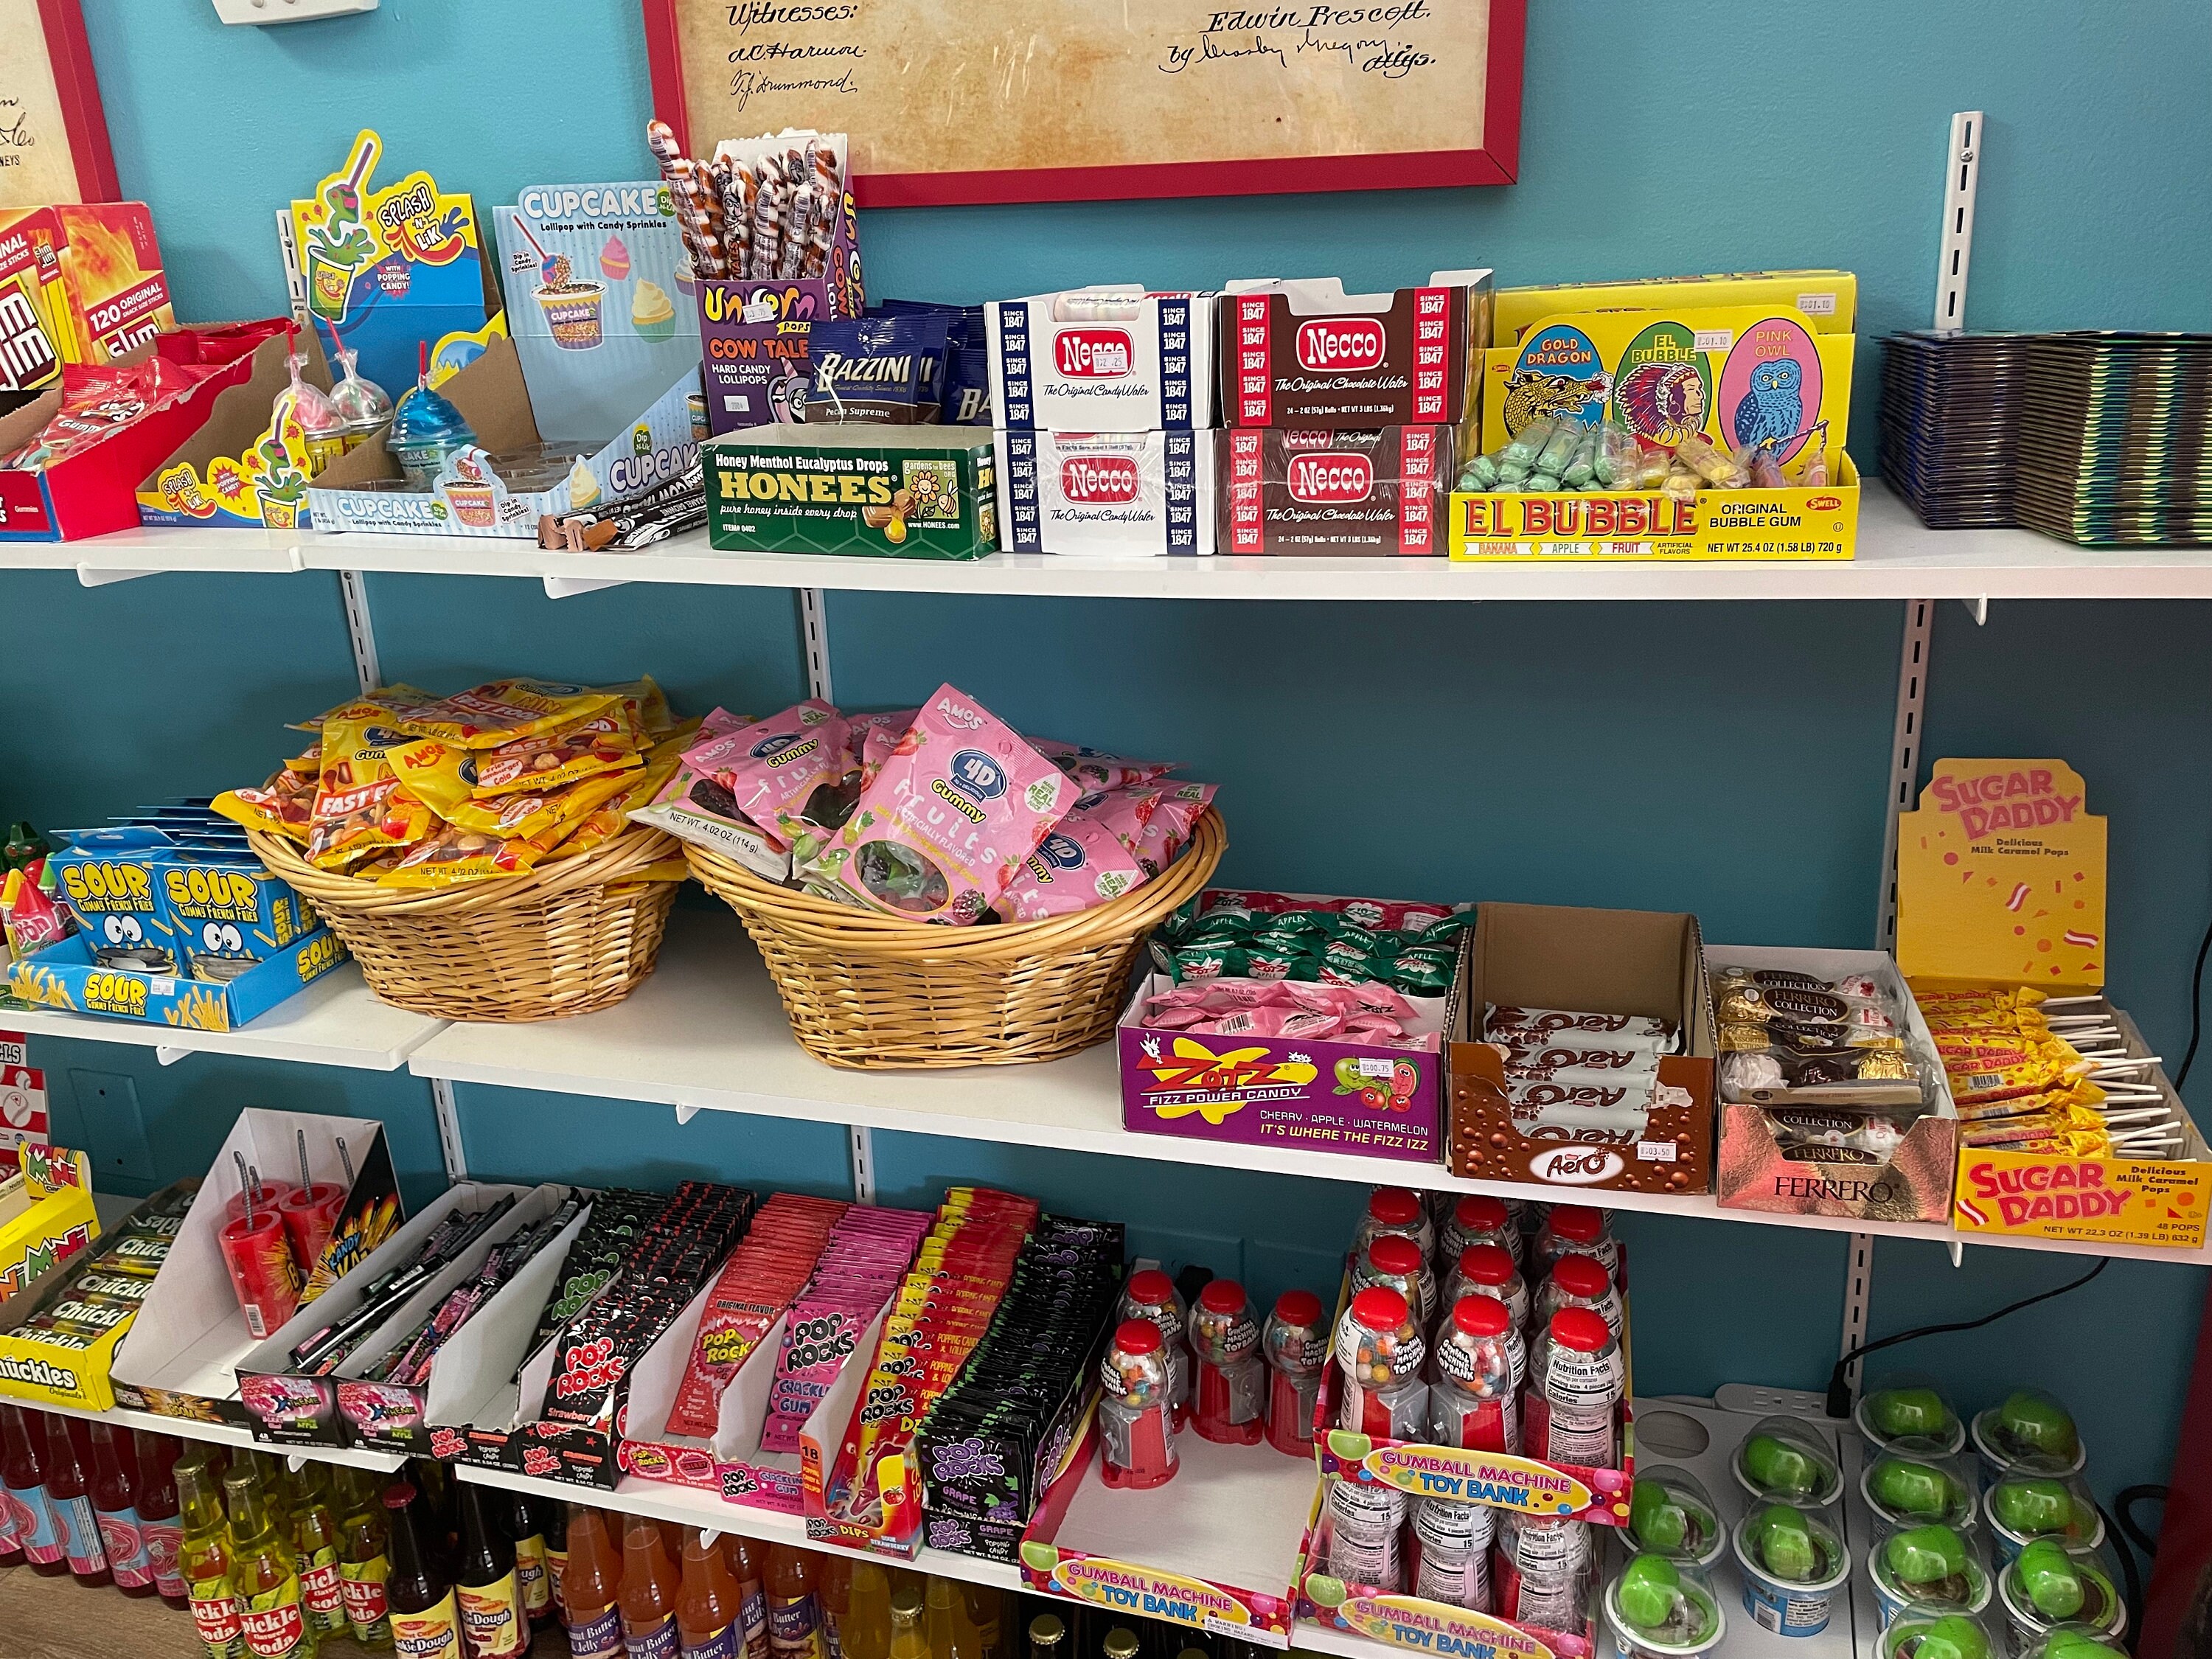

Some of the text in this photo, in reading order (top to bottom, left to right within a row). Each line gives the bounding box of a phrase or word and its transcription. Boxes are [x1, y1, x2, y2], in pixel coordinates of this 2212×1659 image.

[726, 1, 858, 35] Witnesses:
[1198, 0, 1431, 33] Edwin Prescott.
[381, 187, 430, 226] SPLASH
[524, 188, 657, 219] CUPCAKE
[540, 220, 667, 232] Lollipop with Candy Sprinkles
[377, 273, 410, 282] POPPING
[380, 282, 409, 291] CANDY!
[120, 282, 162, 309] ORIGINAL
[122, 293, 163, 317] SNACK SIZE STICKS
[90, 304, 121, 332] 120
[1004, 316, 1023, 327] 1847
[1541, 338, 1579, 352] GOLD
[1655, 335, 1675, 348] EL
[1756, 330, 1792, 342] PINK
[709, 338, 757, 359] COW
[1307, 328, 1377, 365] Necco
[1631, 348, 1696, 362] BUBBLE
[1755, 344, 1790, 357] OWL
[1526, 349, 1592, 366] DRAGON
[712, 364, 771, 375] HARD CANDY
[817, 354, 911, 392] BAZZINI
[718, 375, 767, 384] LOLLIPOPS
[1274, 376, 1408, 392] The Original Chocolate Wafer
[850, 407, 890, 417] Supreme
[715, 453, 888, 472] Honey Menthol Eucalyptus Drops
[903, 461, 956, 475] gardens bees
[718, 472, 892, 505] HONEES
[1069, 464, 1132, 497] Necco
[1298, 462, 1364, 496] Necco
[720, 504, 858, 521] pure honey inside every drop
[1721, 503, 1787, 515] ORIGINAL
[1810, 497, 1840, 509] SWELL
[1050, 509, 1155, 524] The Original Candy Wafer
[1464, 498, 1699, 538] EL BUBBLE
[1709, 515, 1802, 529] BUBBLE GUM
[1478, 543, 1517, 554] BANANA
[1551, 543, 1579, 554] APPLE
[1612, 542, 1641, 554] FRUIT
[1707, 542, 1842, 554] NET WT 25.4 OZ (1.58 LB) 720 g
[937, 698, 983, 731] AMOS
[767, 739, 819, 768] Gummy
[964, 757, 995, 786] 4D
[1028, 785, 1052, 807] REAL
[1930, 769, 2053, 812] SUGAR
[931, 779, 987, 824] Gummy
[1958, 795, 2081, 841] DADDY
[670, 813, 759, 853] NET WT. 4.02 OZ (114 g)
[62, 863, 151, 900] SOUR
[166, 869, 258, 909] SOUR
[1774, 990, 1837, 1008] FERRERO
[1775, 1000, 1837, 1016] COLLECTION
[1135, 1054, 1283, 1093] ZOTZ
[1149, 1088, 1301, 1105] FIZZ POWER CANDY
[1260, 1110, 1428, 1136] CHERRY APPLE WATERMELON
[1260, 1124, 1429, 1150] IT'S WHERE THE FIZZ IZZ
[2116, 1175, 2199, 1185] Milk Caramel
[2131, 1166, 2186, 1175] Delicious
[1773, 1176, 1893, 1203] FERRERO
[1967, 1162, 2105, 1199] SUGAR
[2141, 1185, 2170, 1194] Pops
[1996, 1188, 2135, 1228] DADDY
[2085, 1228, 2106, 1237] 22.3
[2126, 1231, 2149, 1240] (1.39
[2152, 1233, 2168, 1242] LB)
[2172, 1234, 2189, 1242] 632
[2191, 1236, 2198, 1244] g
[717, 1300, 774, 1315] ORIGINAL FLAVOR
[795, 1313, 843, 1346] POP
[566, 1337, 613, 1371] POP
[787, 1332, 855, 1373] ROCKS
[1553, 1360, 1610, 1375] Nutrition Facts
[557, 1357, 625, 1399] ROCKS
[49, 1388, 81, 1399] Originals
[1548, 1390, 1615, 1405] Calories 15
[780, 1399, 811, 1414] GUM
[932, 1438, 984, 1462] POP
[933, 1454, 1005, 1482] ROCKS
[1380, 1450, 1572, 1494] GUMBALL MACHINE
[943, 1486, 977, 1505] GRAPE
[1420, 1473, 1529, 1507] TOY BANK
[839, 1524, 869, 1538] DIPS
[1067, 1562, 1233, 1613] GUMBALL MACHINE
[1102, 1585, 1197, 1621] TOY BANK
[586, 1614, 617, 1634] Butter
[252, 1634, 294, 1653] soda
[577, 1638, 598, 1652] Jelly
